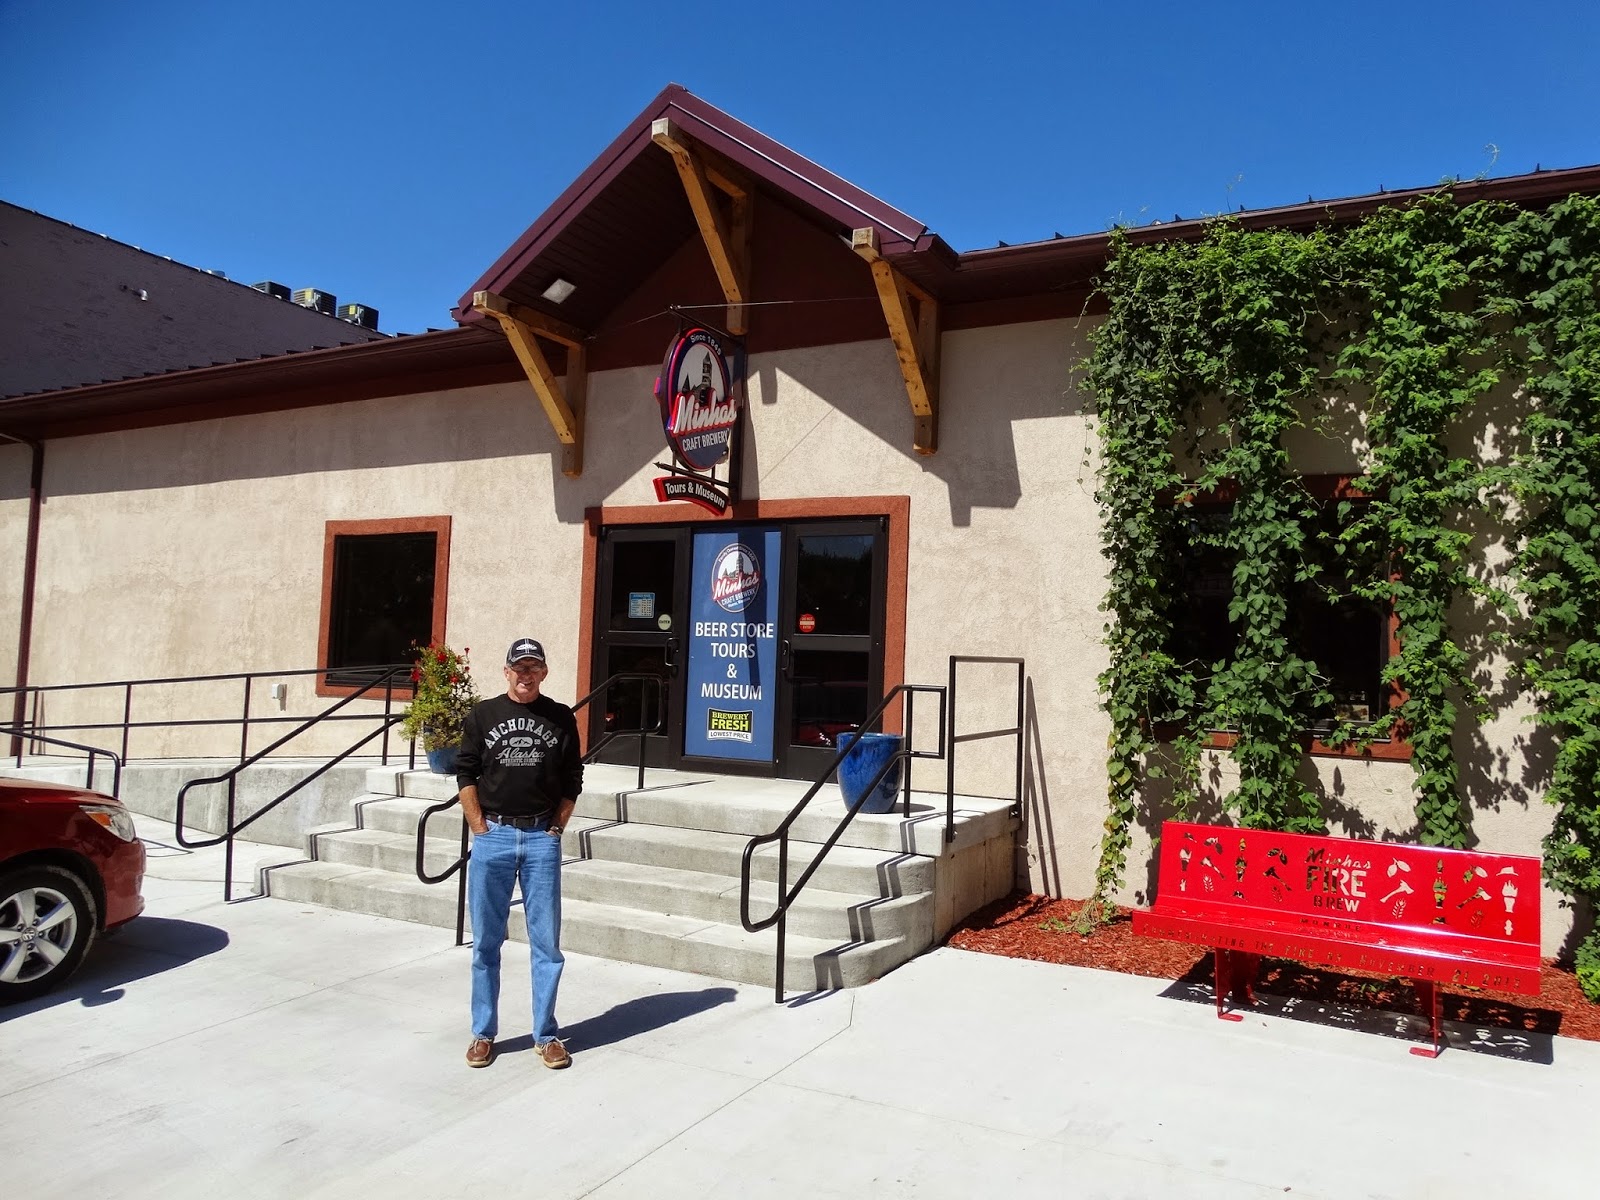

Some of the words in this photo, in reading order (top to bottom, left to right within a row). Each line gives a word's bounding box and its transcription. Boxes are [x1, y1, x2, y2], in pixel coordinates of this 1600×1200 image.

[673, 390, 737, 434] Minhas
[682, 435, 701, 452] CRAFT
[701, 430, 728, 447] BREWERY
[665, 482, 686, 495] Tours
[687, 481, 694, 494] &
[695, 483, 725, 508] Museum
[713, 572, 759, 600] Minhas
[721, 594, 735, 606] CRAFT
[735, 588, 755, 600] BREWERY
[695, 622, 727, 637] BEER
[731, 622, 774, 638] STORE
[711, 642, 756, 659] TOURS
[726, 663, 737, 679] &
[701, 683, 762, 700] MUSEUM
[711, 718, 749, 731] FRESH
[712, 711, 749, 721] BREWERY
[484, 717, 558, 749] ANCHORAGE
[733, 732, 749, 740] PRICE
[495, 747, 545, 760] Alaska
[1304, 847, 1371, 869] Minhas
[1306, 866, 1367, 898] FIRE
[1313, 895, 1360, 913] BREW
[1143, 923, 1245, 948] COMMEMRATING
[1284, 944, 1313, 959] FIRE
